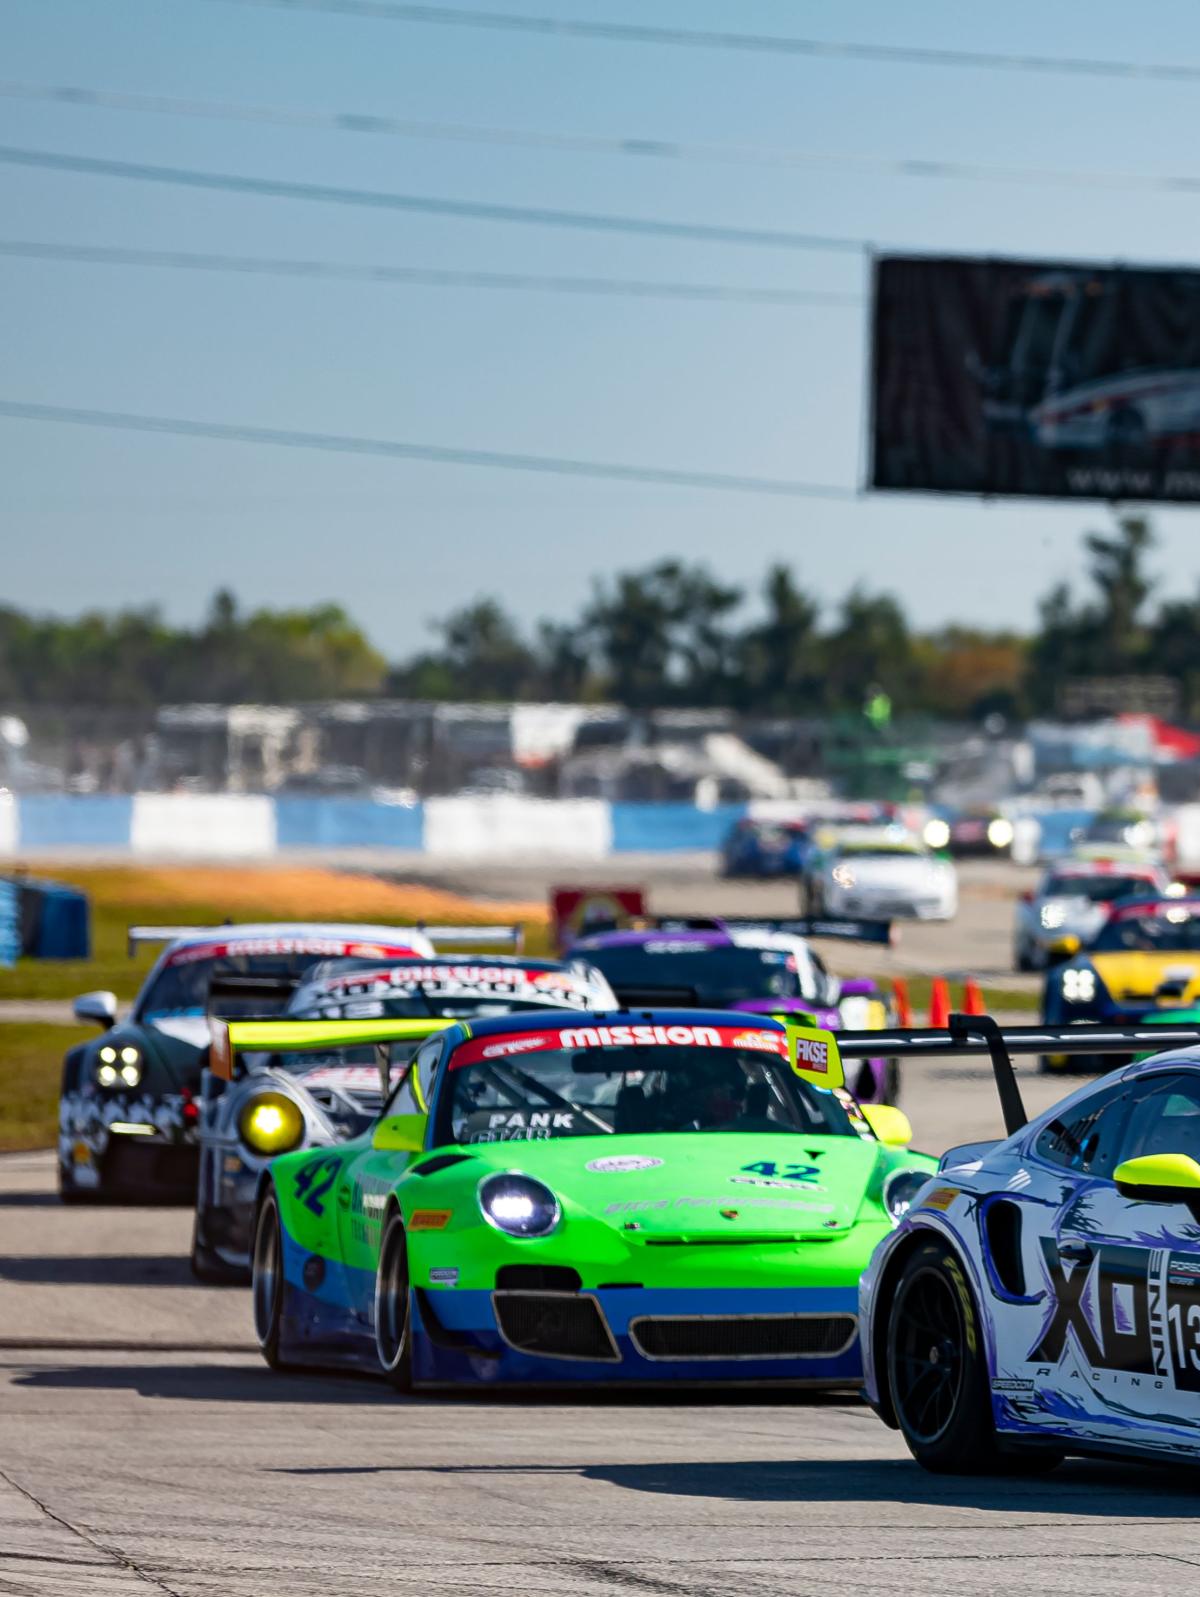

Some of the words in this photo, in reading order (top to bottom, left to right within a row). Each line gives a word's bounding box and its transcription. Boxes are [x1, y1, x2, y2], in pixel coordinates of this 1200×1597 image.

[559, 1026, 722, 1047] mission
[797, 1039, 828, 1063] FIKSE
[489, 1113, 574, 1129] PANK
[740, 1161, 821, 1184] 42
[294, 1155, 343, 1217] 42
[1147, 1248, 1169, 1377] NINE
[1036, 1367, 1164, 1390] RACING
